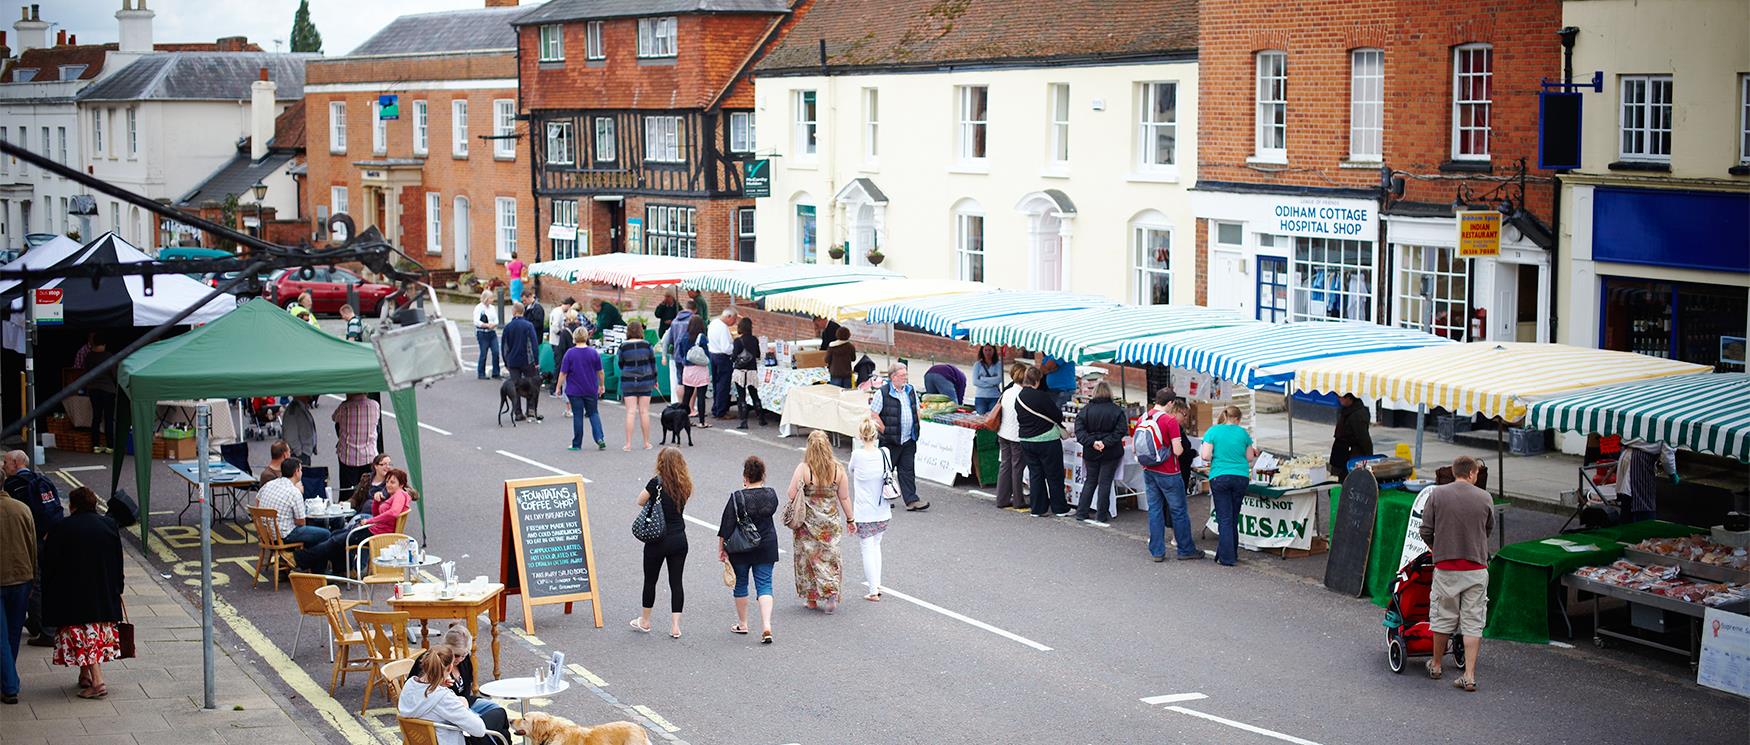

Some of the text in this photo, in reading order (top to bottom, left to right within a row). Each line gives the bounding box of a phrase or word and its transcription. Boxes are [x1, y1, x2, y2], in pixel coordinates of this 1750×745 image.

[1275, 206, 1368, 221] ODIHAM COTTAGE
[1280, 220, 1362, 235] HOSPITAL SHOP
[1470, 223, 1490, 231] INDIAN
[1462, 231, 1497, 239] RESTAURANT
[520, 487, 570, 501] FOUNTAINS
[521, 498, 574, 511] COFFEE SHOP
[1272, 501, 1294, 511] NOT
[524, 513, 533, 521] ALL
[545, 510, 577, 519] BREAKFAST
